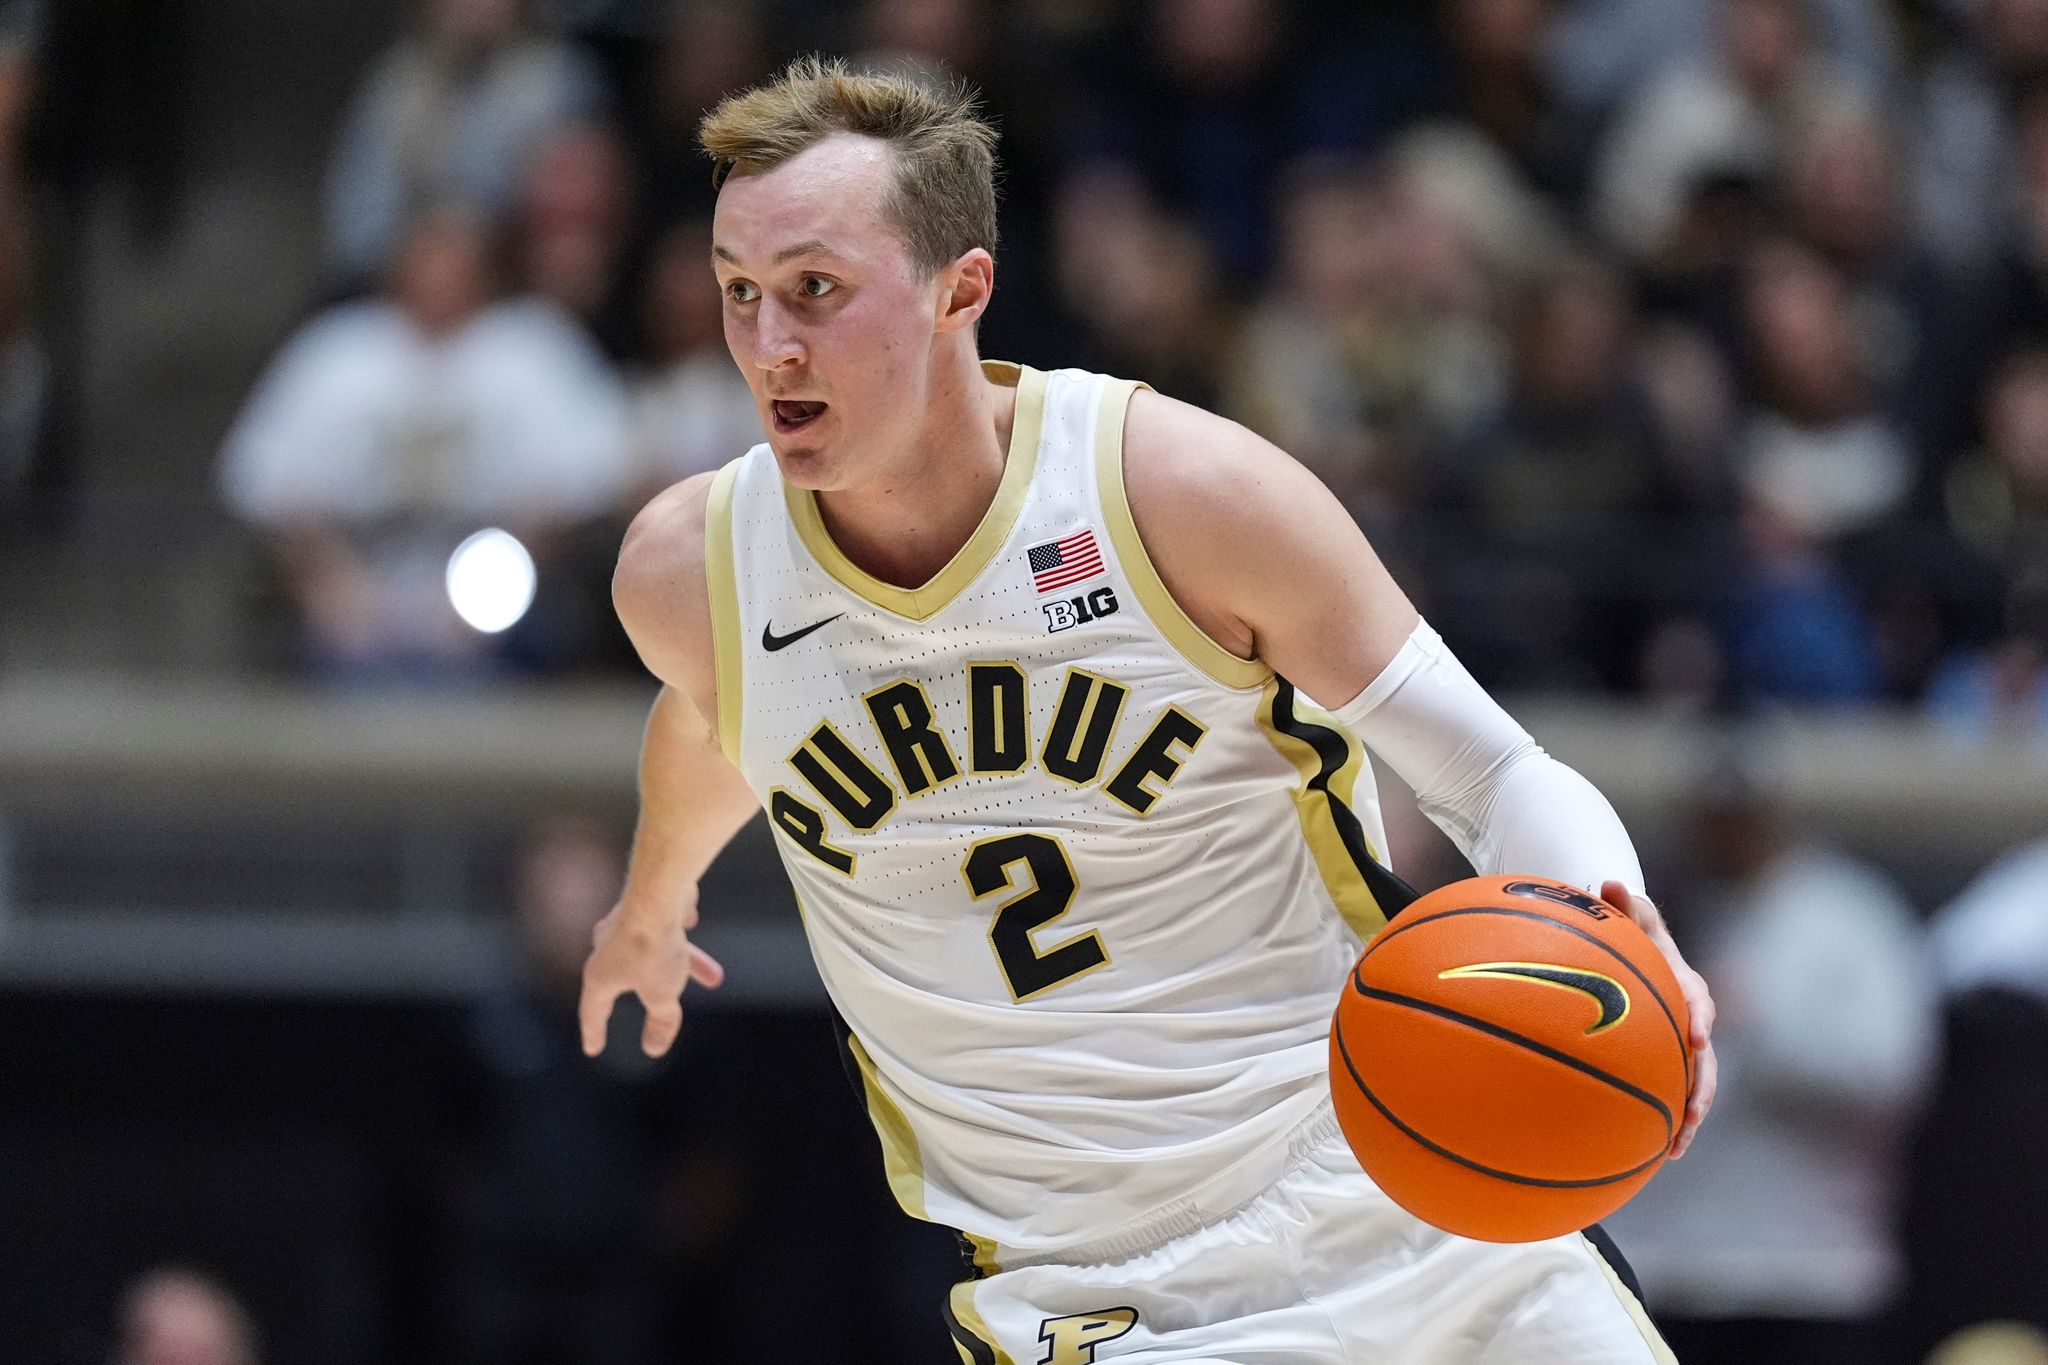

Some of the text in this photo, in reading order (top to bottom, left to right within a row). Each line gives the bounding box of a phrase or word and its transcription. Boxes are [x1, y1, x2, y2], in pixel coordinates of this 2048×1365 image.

[769, 660, 1209, 879] PURDUE
[960, 833, 1112, 1005] 2
[1037, 1306, 1139, 1365] P
